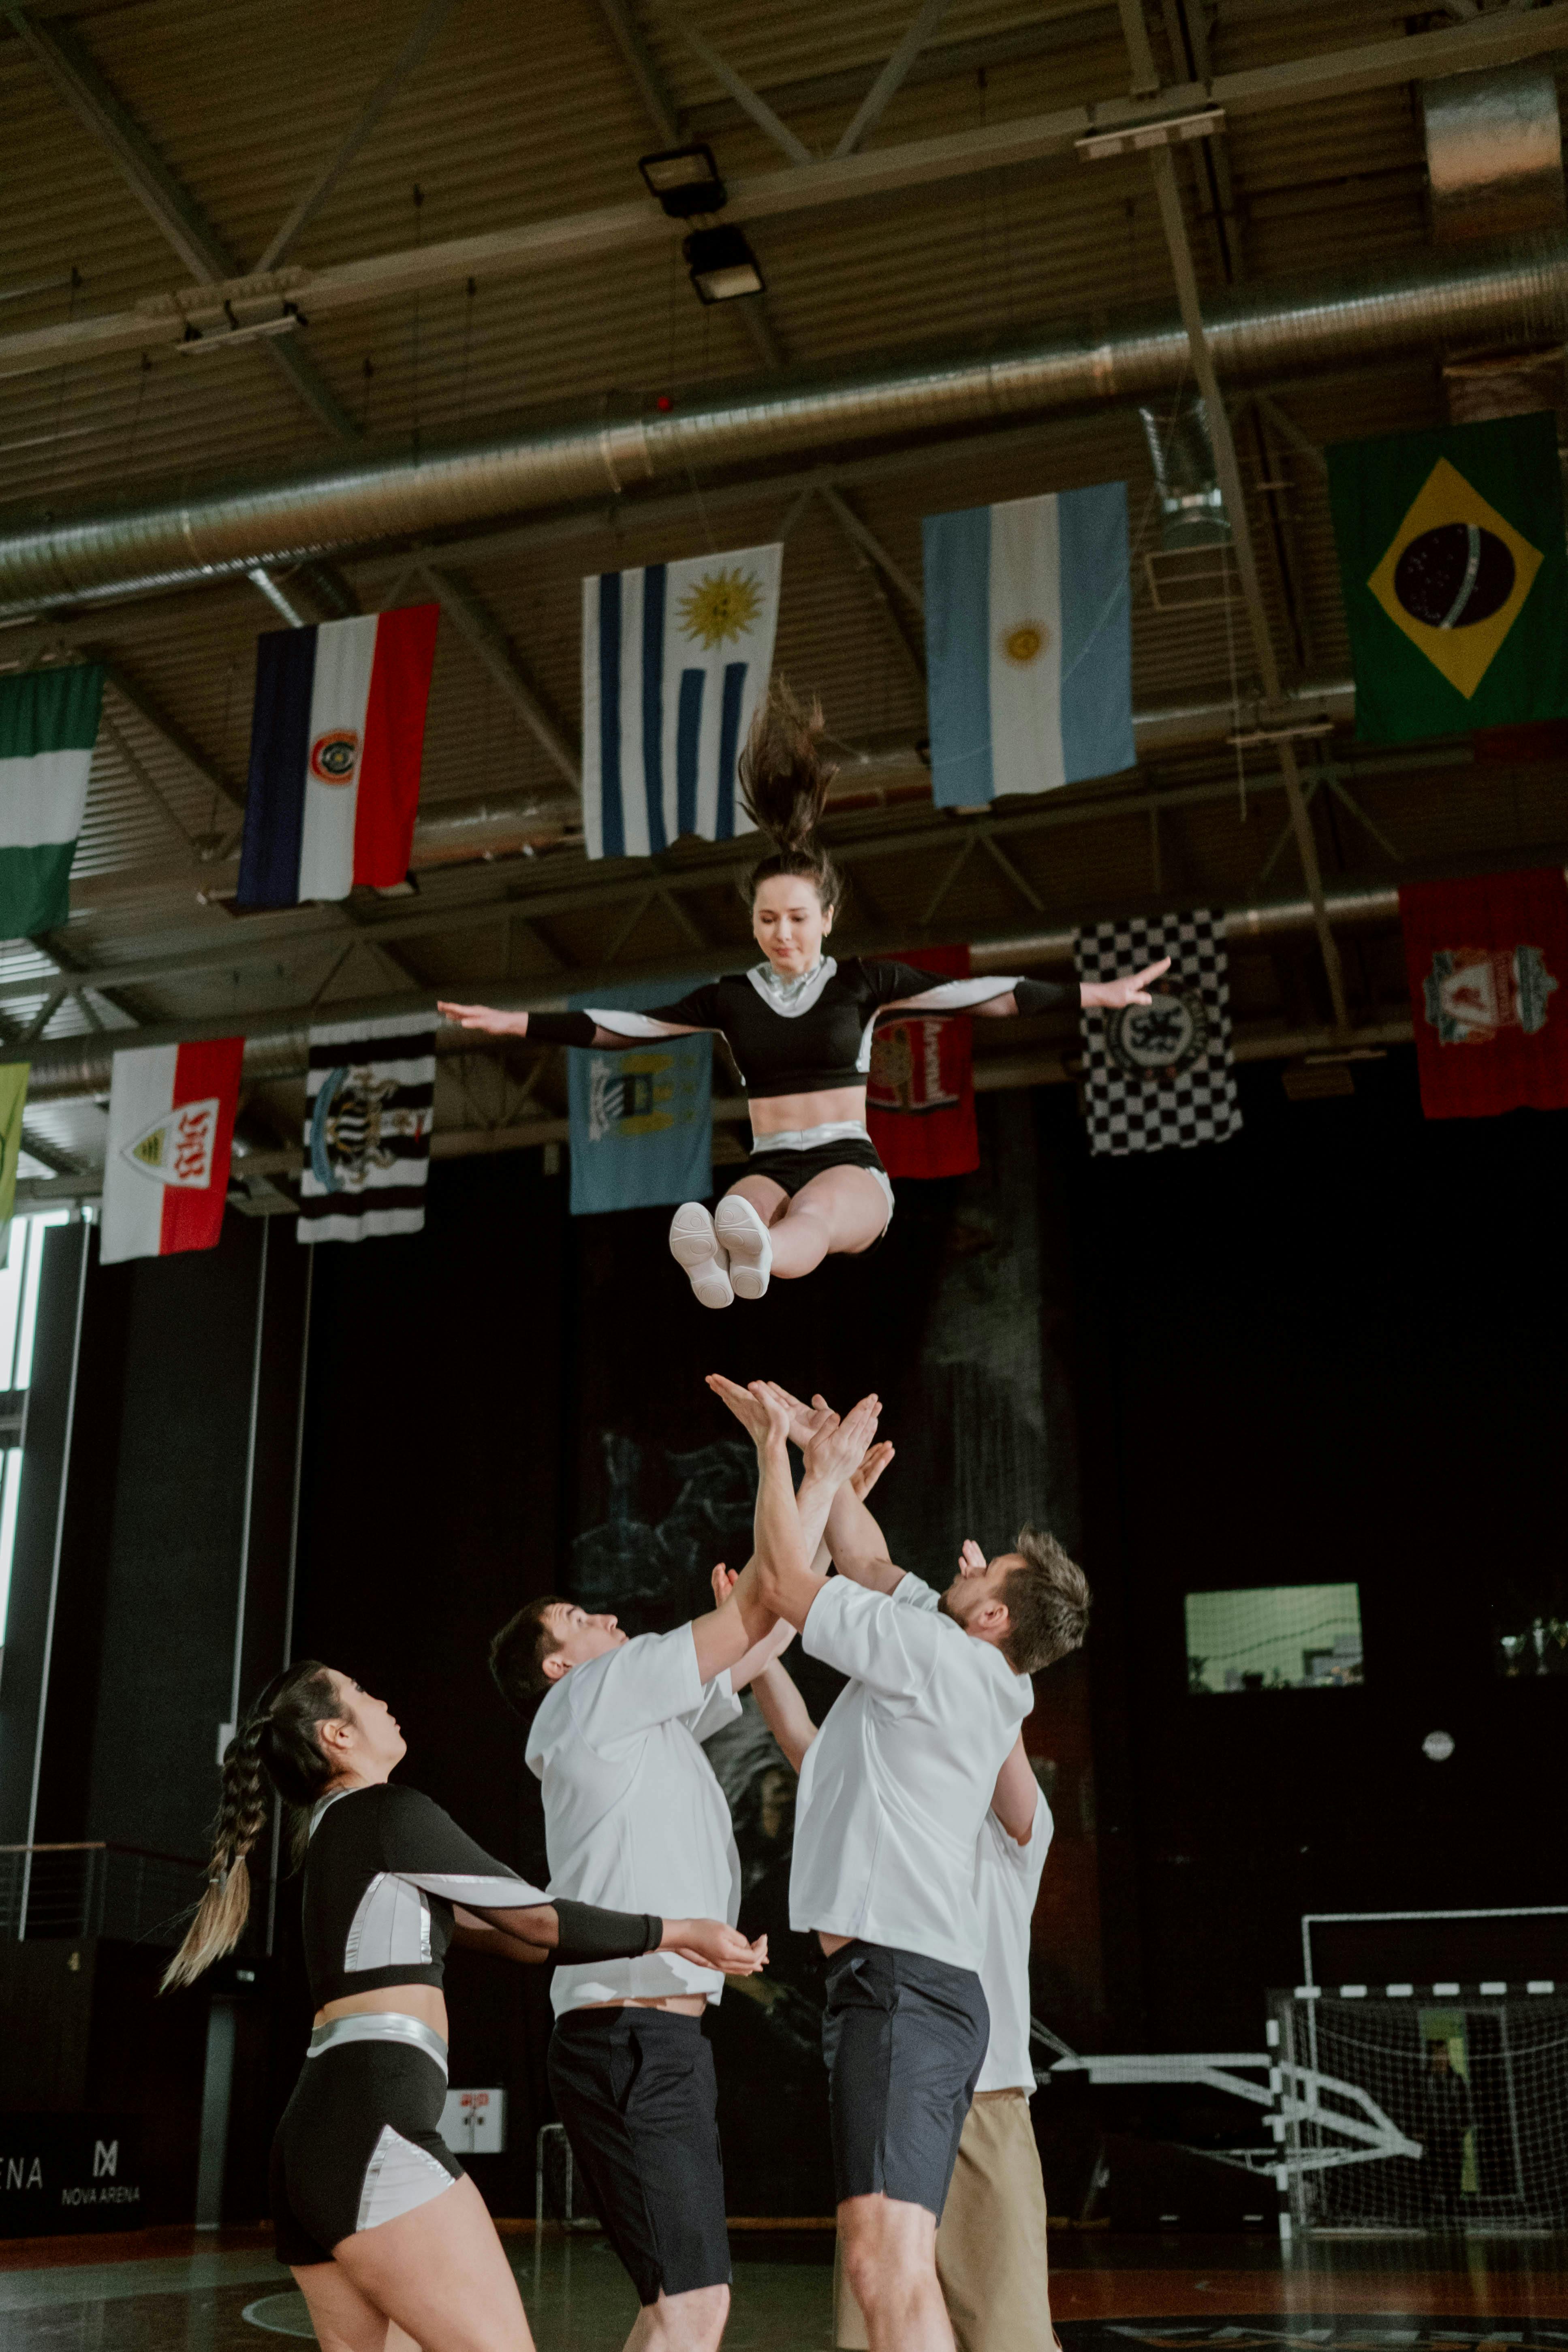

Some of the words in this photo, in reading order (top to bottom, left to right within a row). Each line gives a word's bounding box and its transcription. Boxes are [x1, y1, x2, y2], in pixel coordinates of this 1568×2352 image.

[0, 2157, 43, 2190] NA
[62, 2187, 96, 2206] NOVA
[99, 2186, 140, 2204] ARENA
